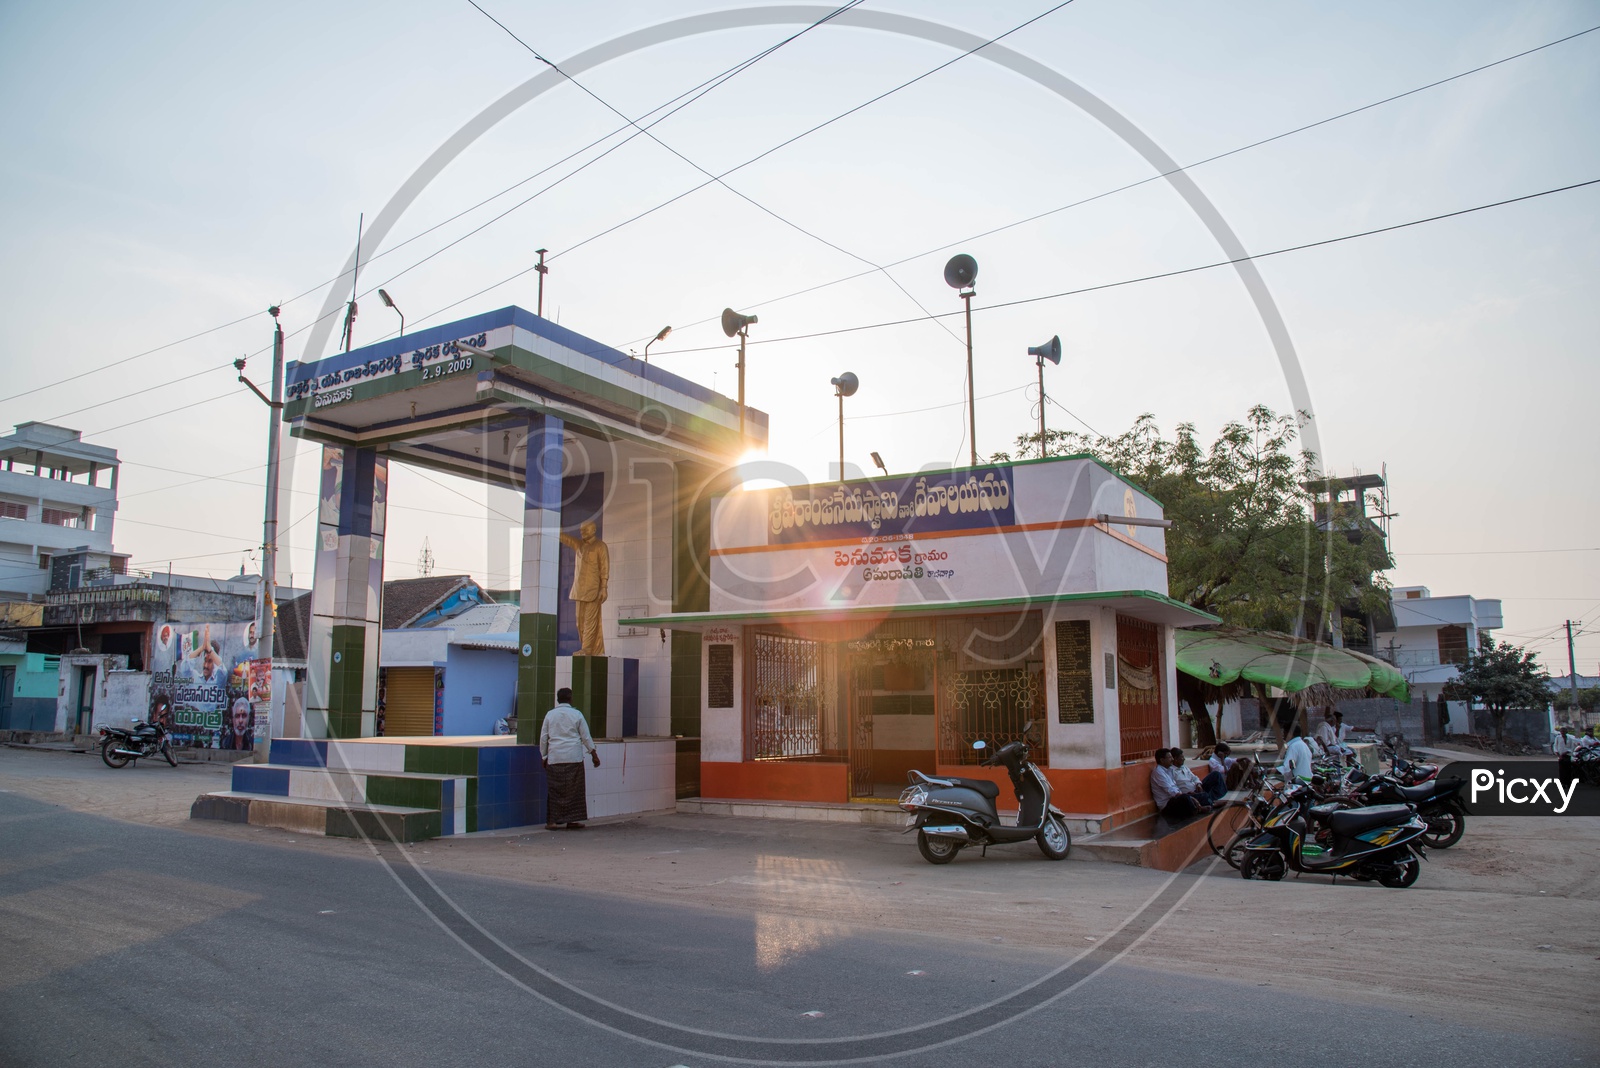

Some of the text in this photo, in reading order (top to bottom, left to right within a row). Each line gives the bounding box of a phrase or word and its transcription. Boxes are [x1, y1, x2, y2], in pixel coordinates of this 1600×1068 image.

[422, 357, 473, 380] 2.9.2009
[914, 472, 1010, 518] దేవాలయము
[834, 544, 948, 567] పెనుమాక గ్రామం
[175, 707, 222, 728] యాత్ర
